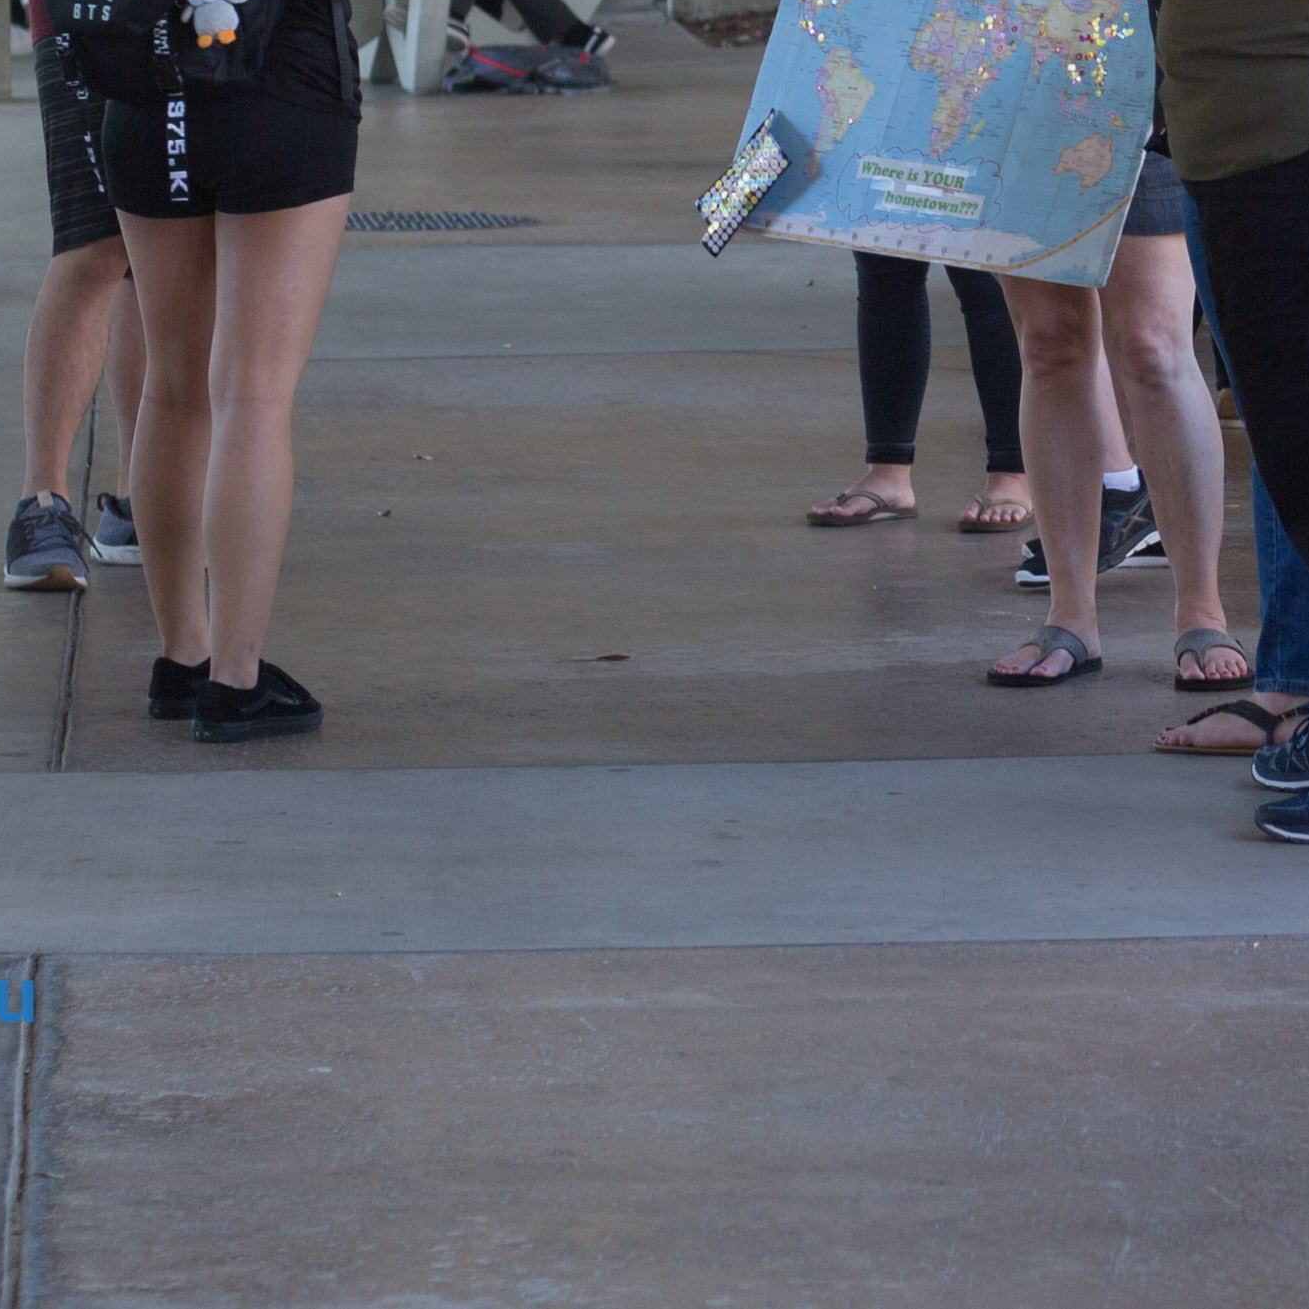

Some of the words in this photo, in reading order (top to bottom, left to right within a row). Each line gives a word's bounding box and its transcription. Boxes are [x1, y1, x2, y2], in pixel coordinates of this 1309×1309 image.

[73, 3, 112, 21] BTS
[861, 160, 903, 180] Where
[906, 168, 919, 182] is
[923, 170, 965, 189] YOUR
[885, 191, 979, 215] hometown???
